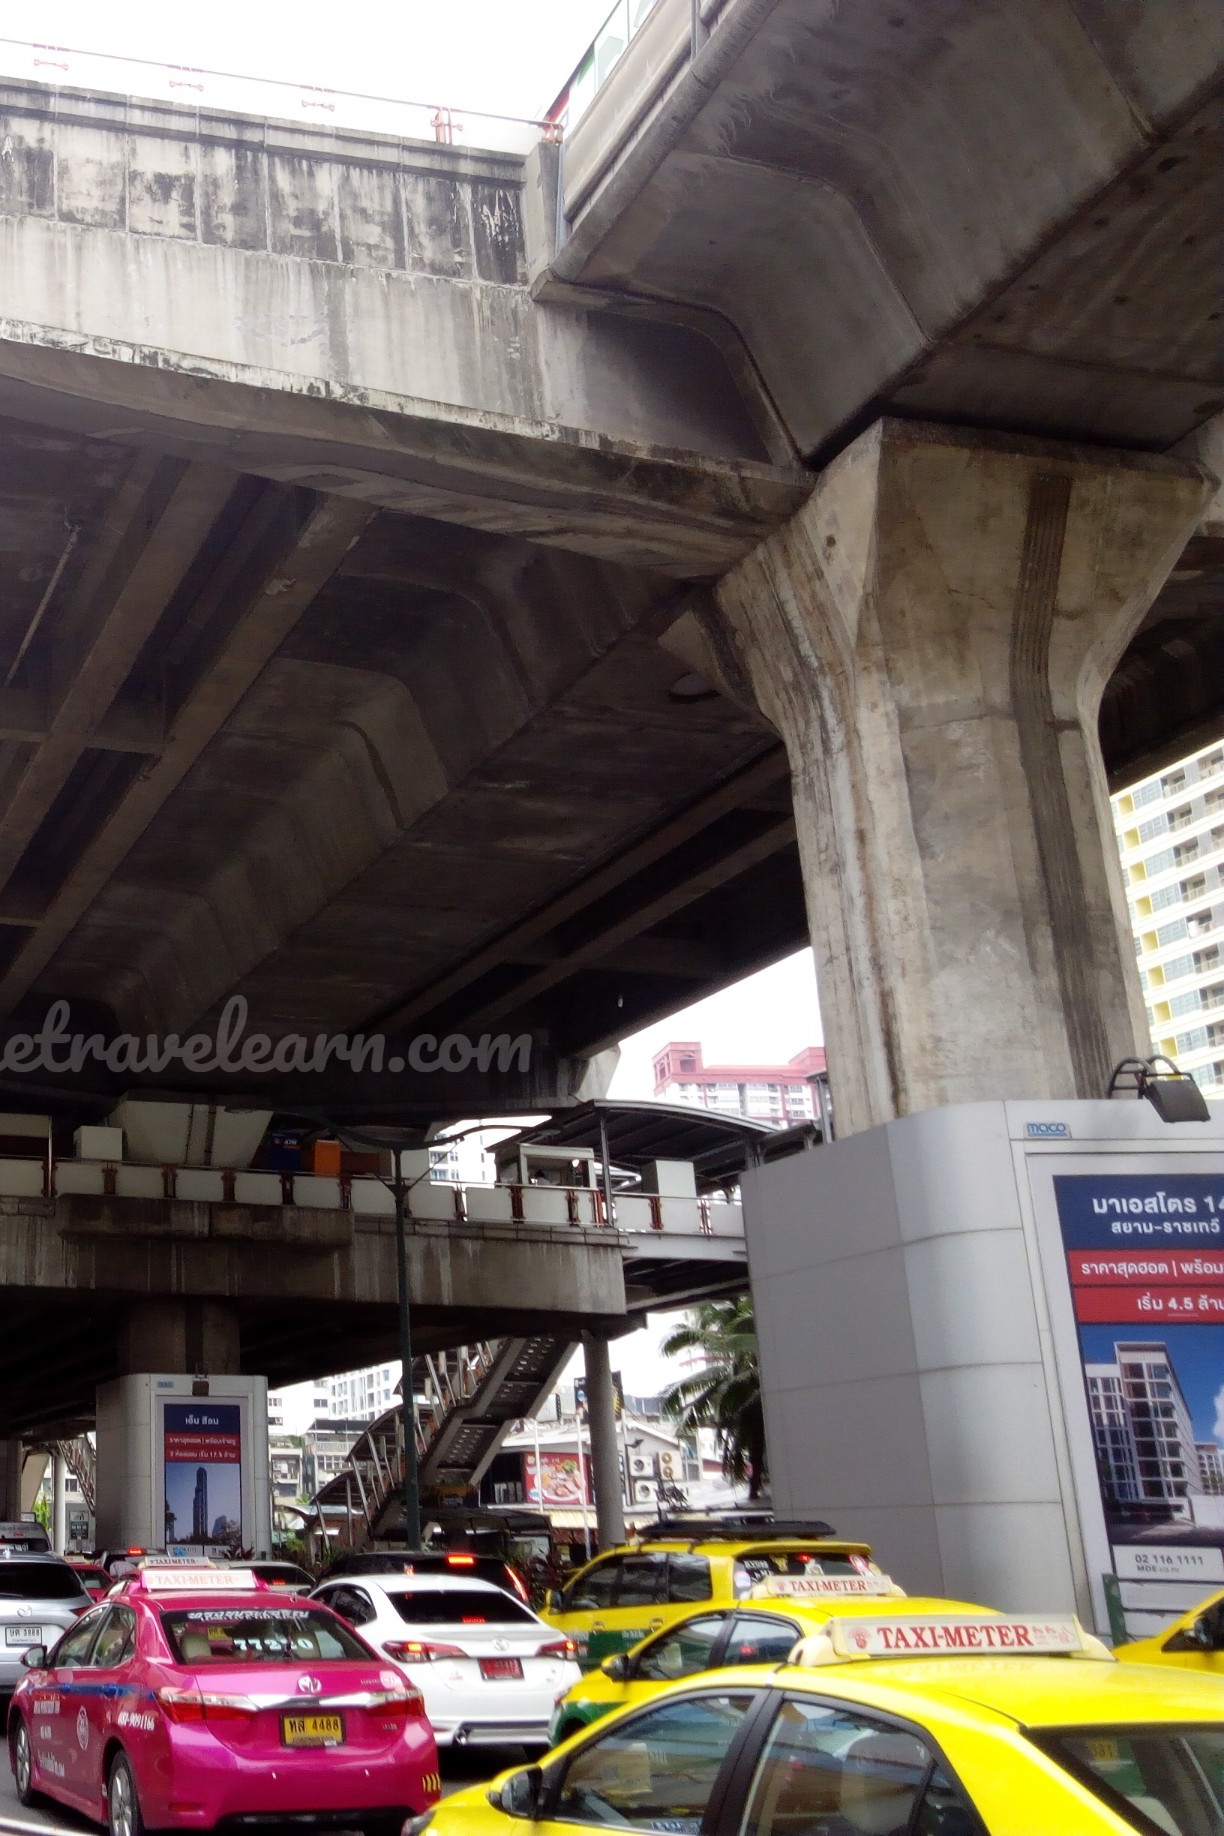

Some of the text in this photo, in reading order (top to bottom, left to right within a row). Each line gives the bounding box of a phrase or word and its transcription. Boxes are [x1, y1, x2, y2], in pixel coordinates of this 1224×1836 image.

[1092, 1191, 1197, 1214] มาเอสโตร
[1111, 1217, 1220, 1234] สยาม-ราชเทวี
[1137, 1291, 1163, 1310] เริ่ม
[1168, 1297, 1194, 1311] 4.5
[1135, 1554, 1203, 1565] 02 116 1111
[789, 1580, 867, 1592] TAXI-METER
[877, 1625, 1034, 1649] TAXI-METER
[312, 1718, 340, 1732] 4488
